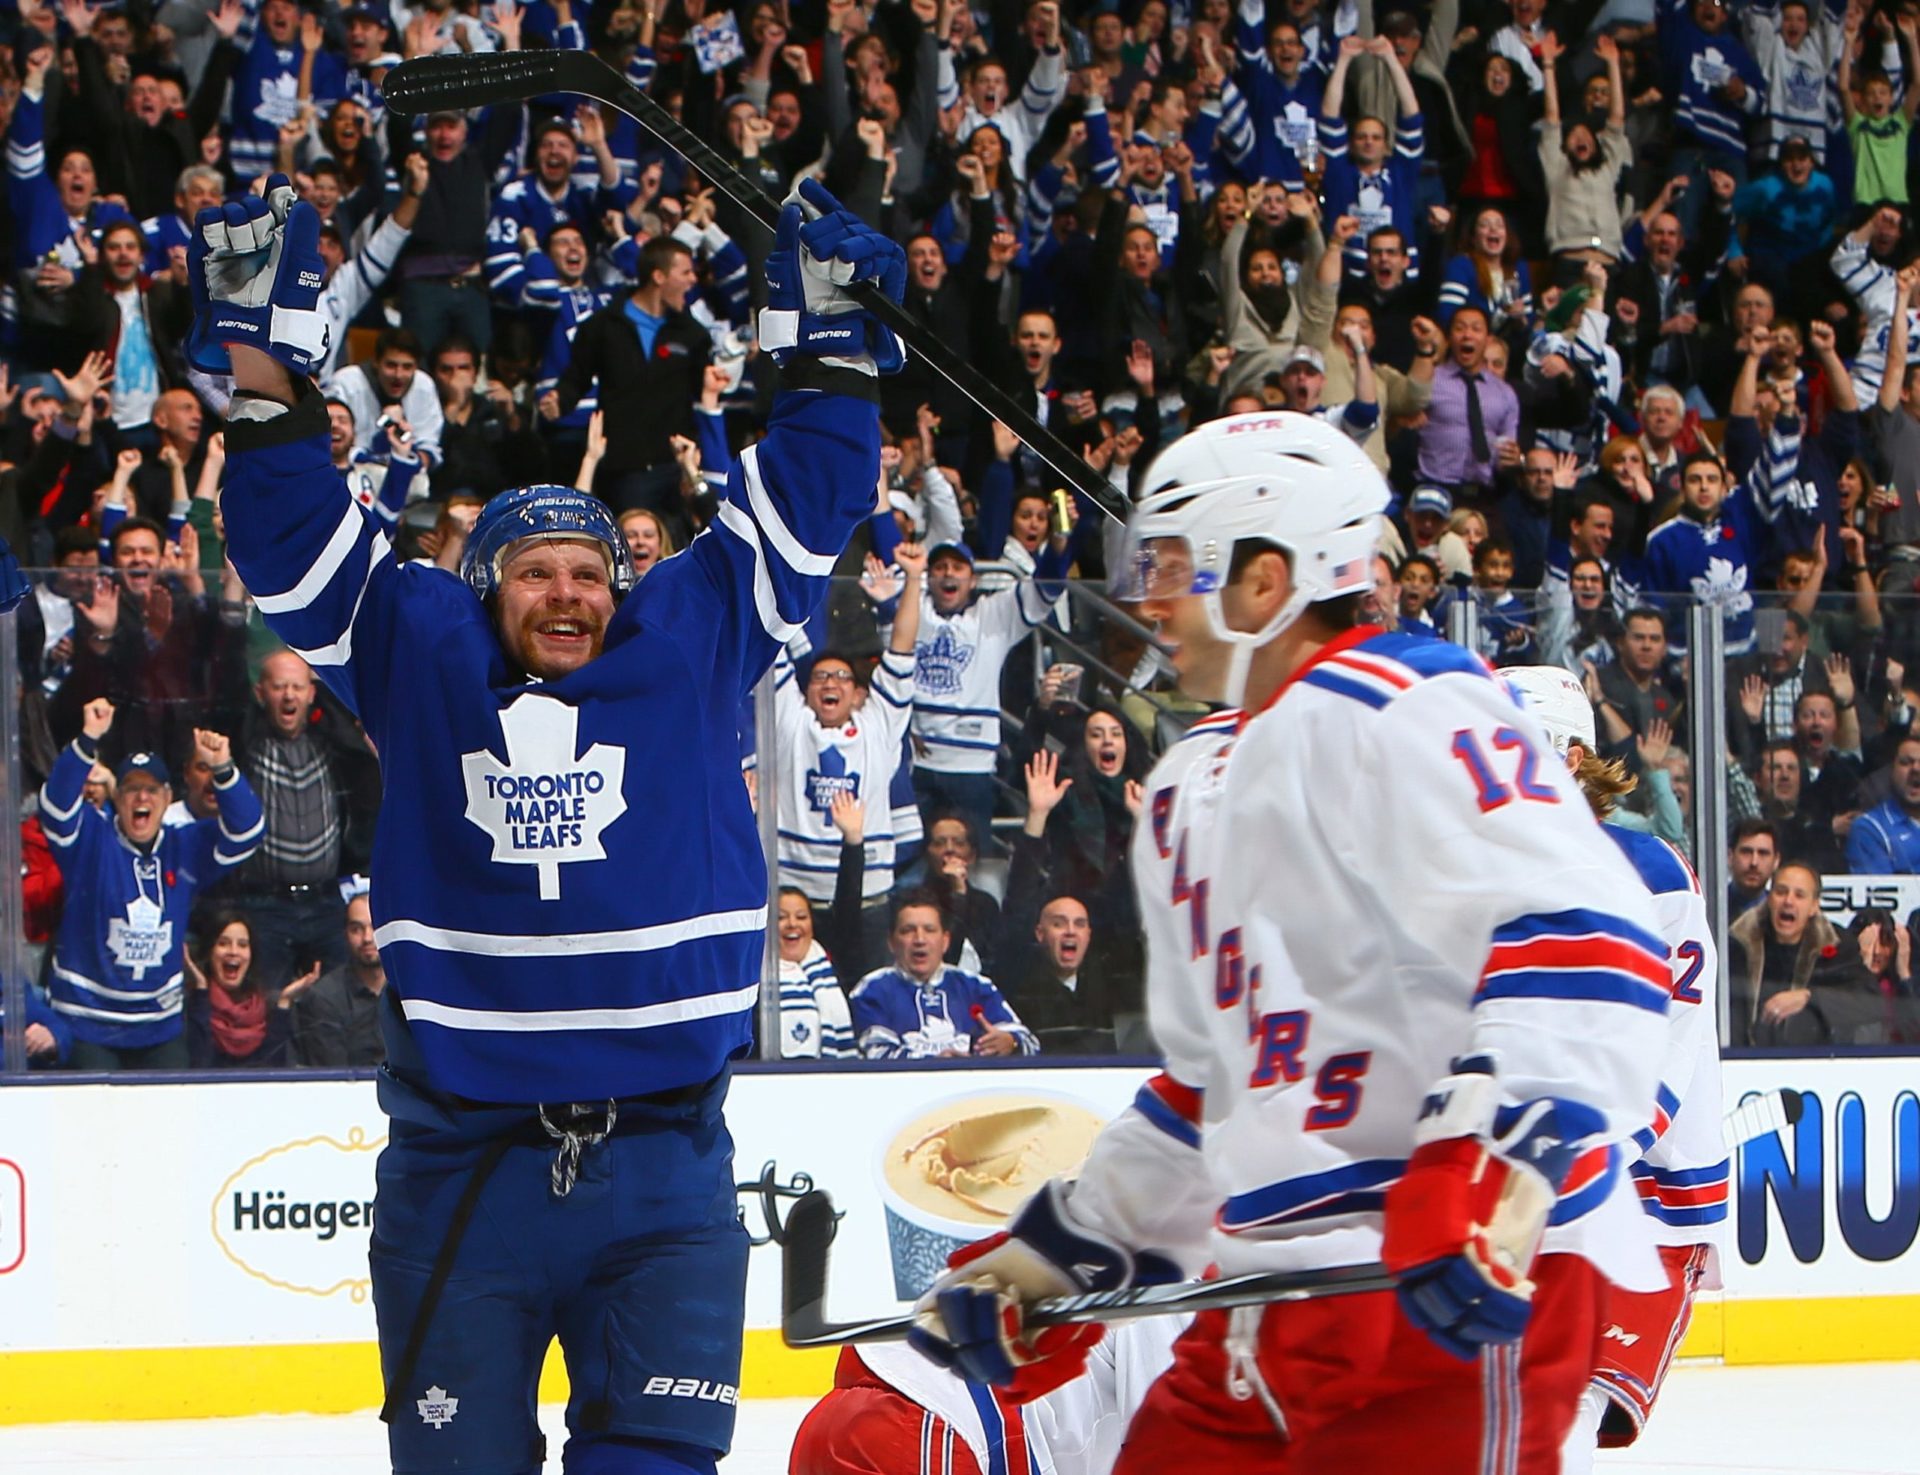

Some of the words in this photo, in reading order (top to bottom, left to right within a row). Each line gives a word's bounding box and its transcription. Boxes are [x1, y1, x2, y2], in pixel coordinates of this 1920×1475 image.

[486, 216, 519, 244] 43
[216, 318, 260, 333] BAUER
[807, 329, 853, 341] BAUER
[1225, 417, 1284, 435] NYR
[1451, 726, 1563, 814] 12
[484, 770, 605, 800] TORONTO
[504, 797, 586, 825] MAPLE
[511, 823, 583, 850] LEAFS
[117, 928, 168, 942] TORONTO
[125, 940, 157, 951] MAPLE
[1737, 1089, 1920, 1265] NU
